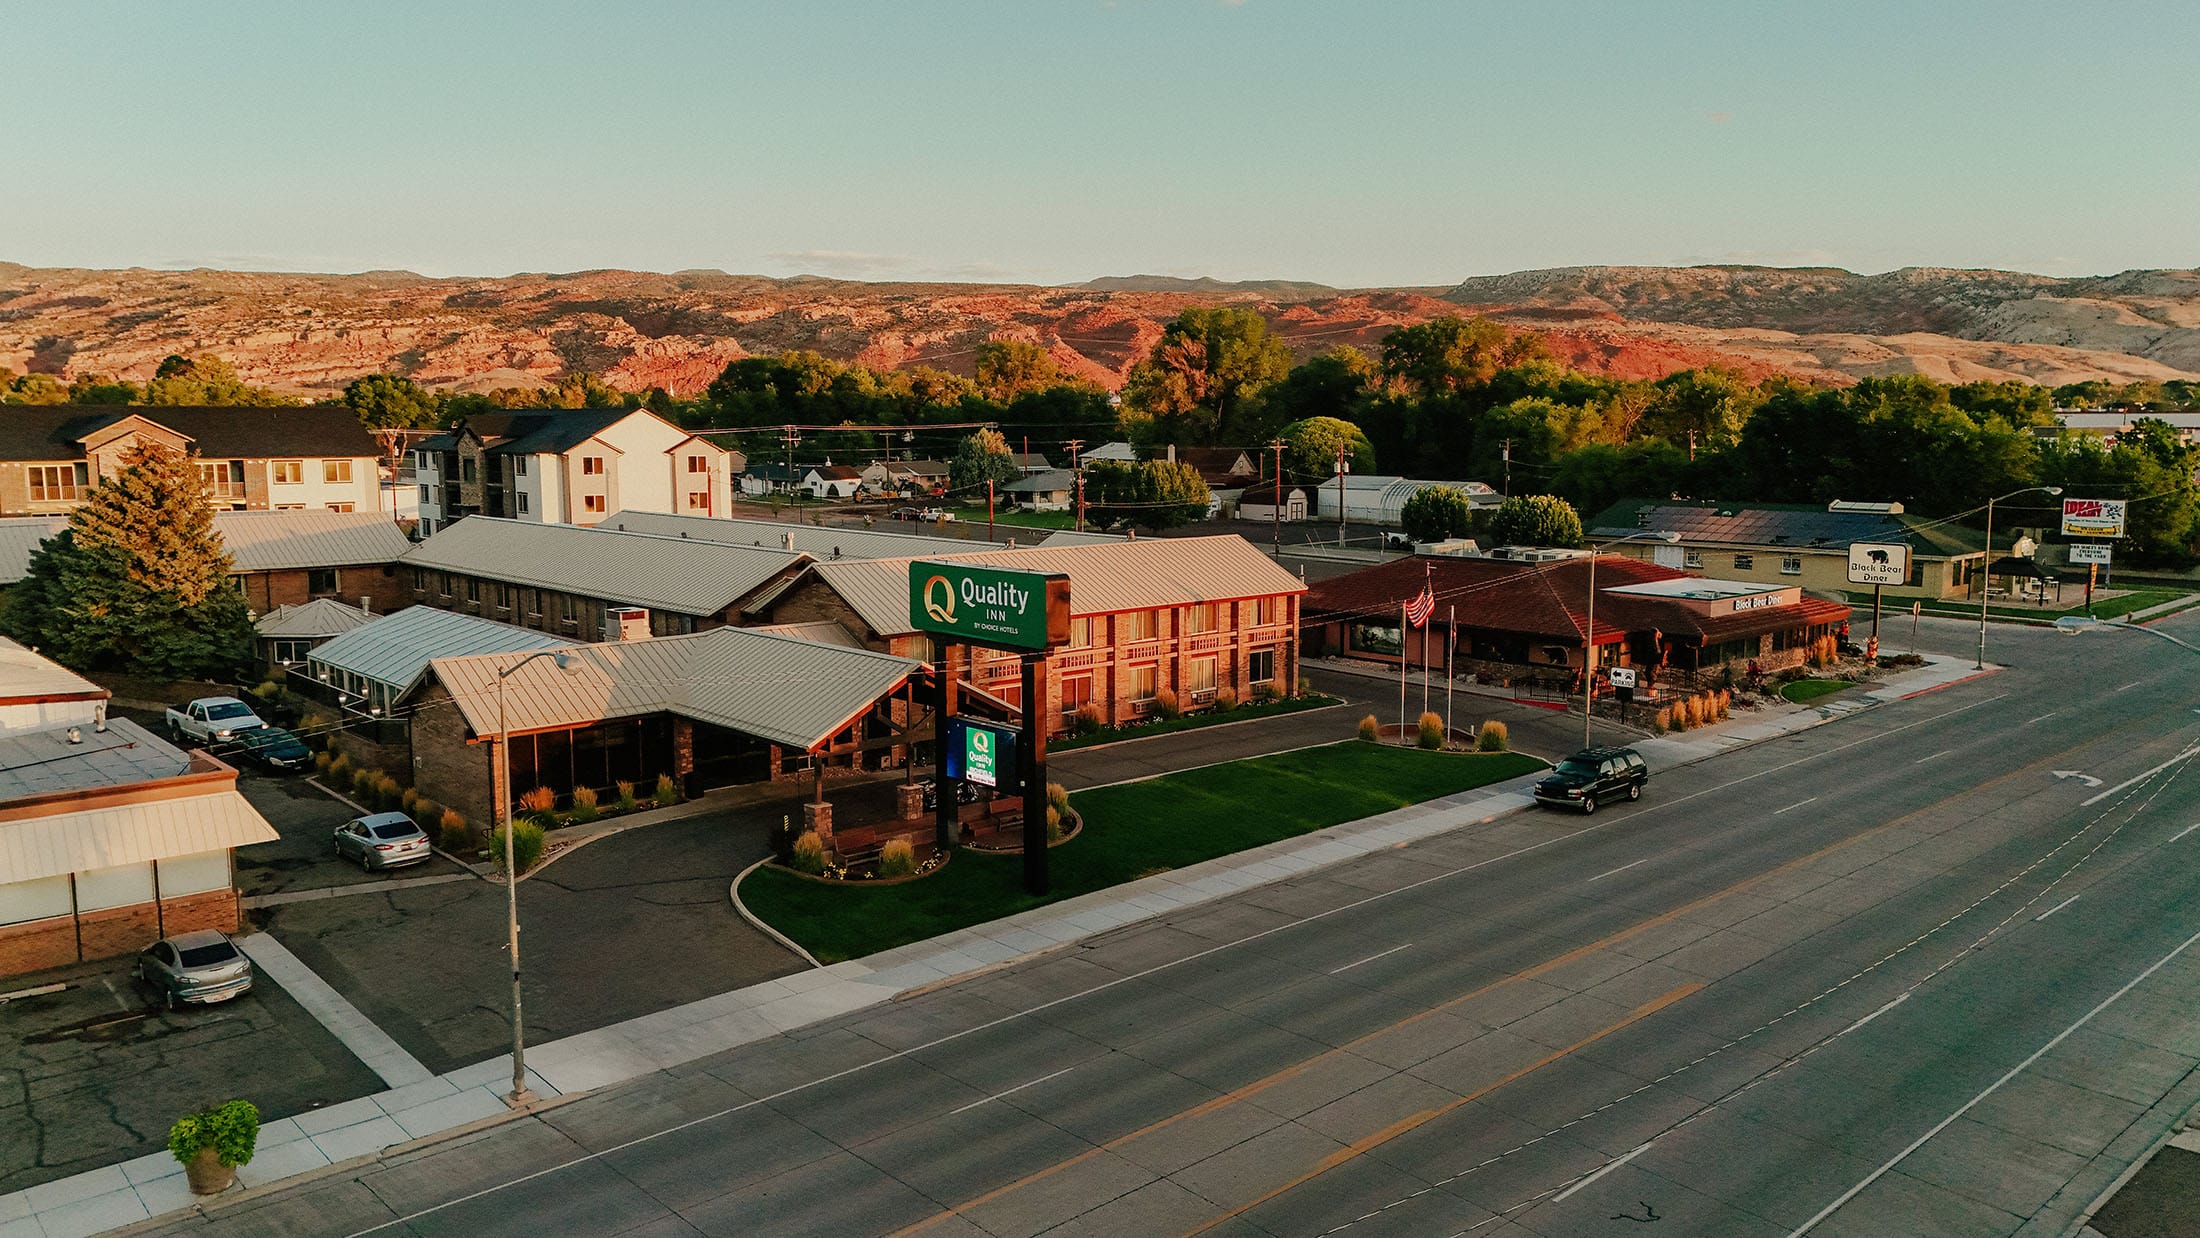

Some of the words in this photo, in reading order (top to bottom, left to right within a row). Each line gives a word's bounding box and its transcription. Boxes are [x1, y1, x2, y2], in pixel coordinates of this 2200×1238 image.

[2064, 501, 2102, 515] IDEAL
[1851, 563, 1876, 572] Black
[1880, 565, 1902, 573] Bear
[1863, 573, 1888, 582] Diner
[961, 577, 1029, 615] Quality
[1735, 600, 1752, 610] Black
[1753, 598, 1767, 608] Bear
[1768, 595, 1783, 605] Diner
[986, 608, 1006, 622] INN
[981, 623, 999, 632] CHOICE
[1000, 626, 1018, 635] HOTELS
[969, 751, 992, 767] Quality
